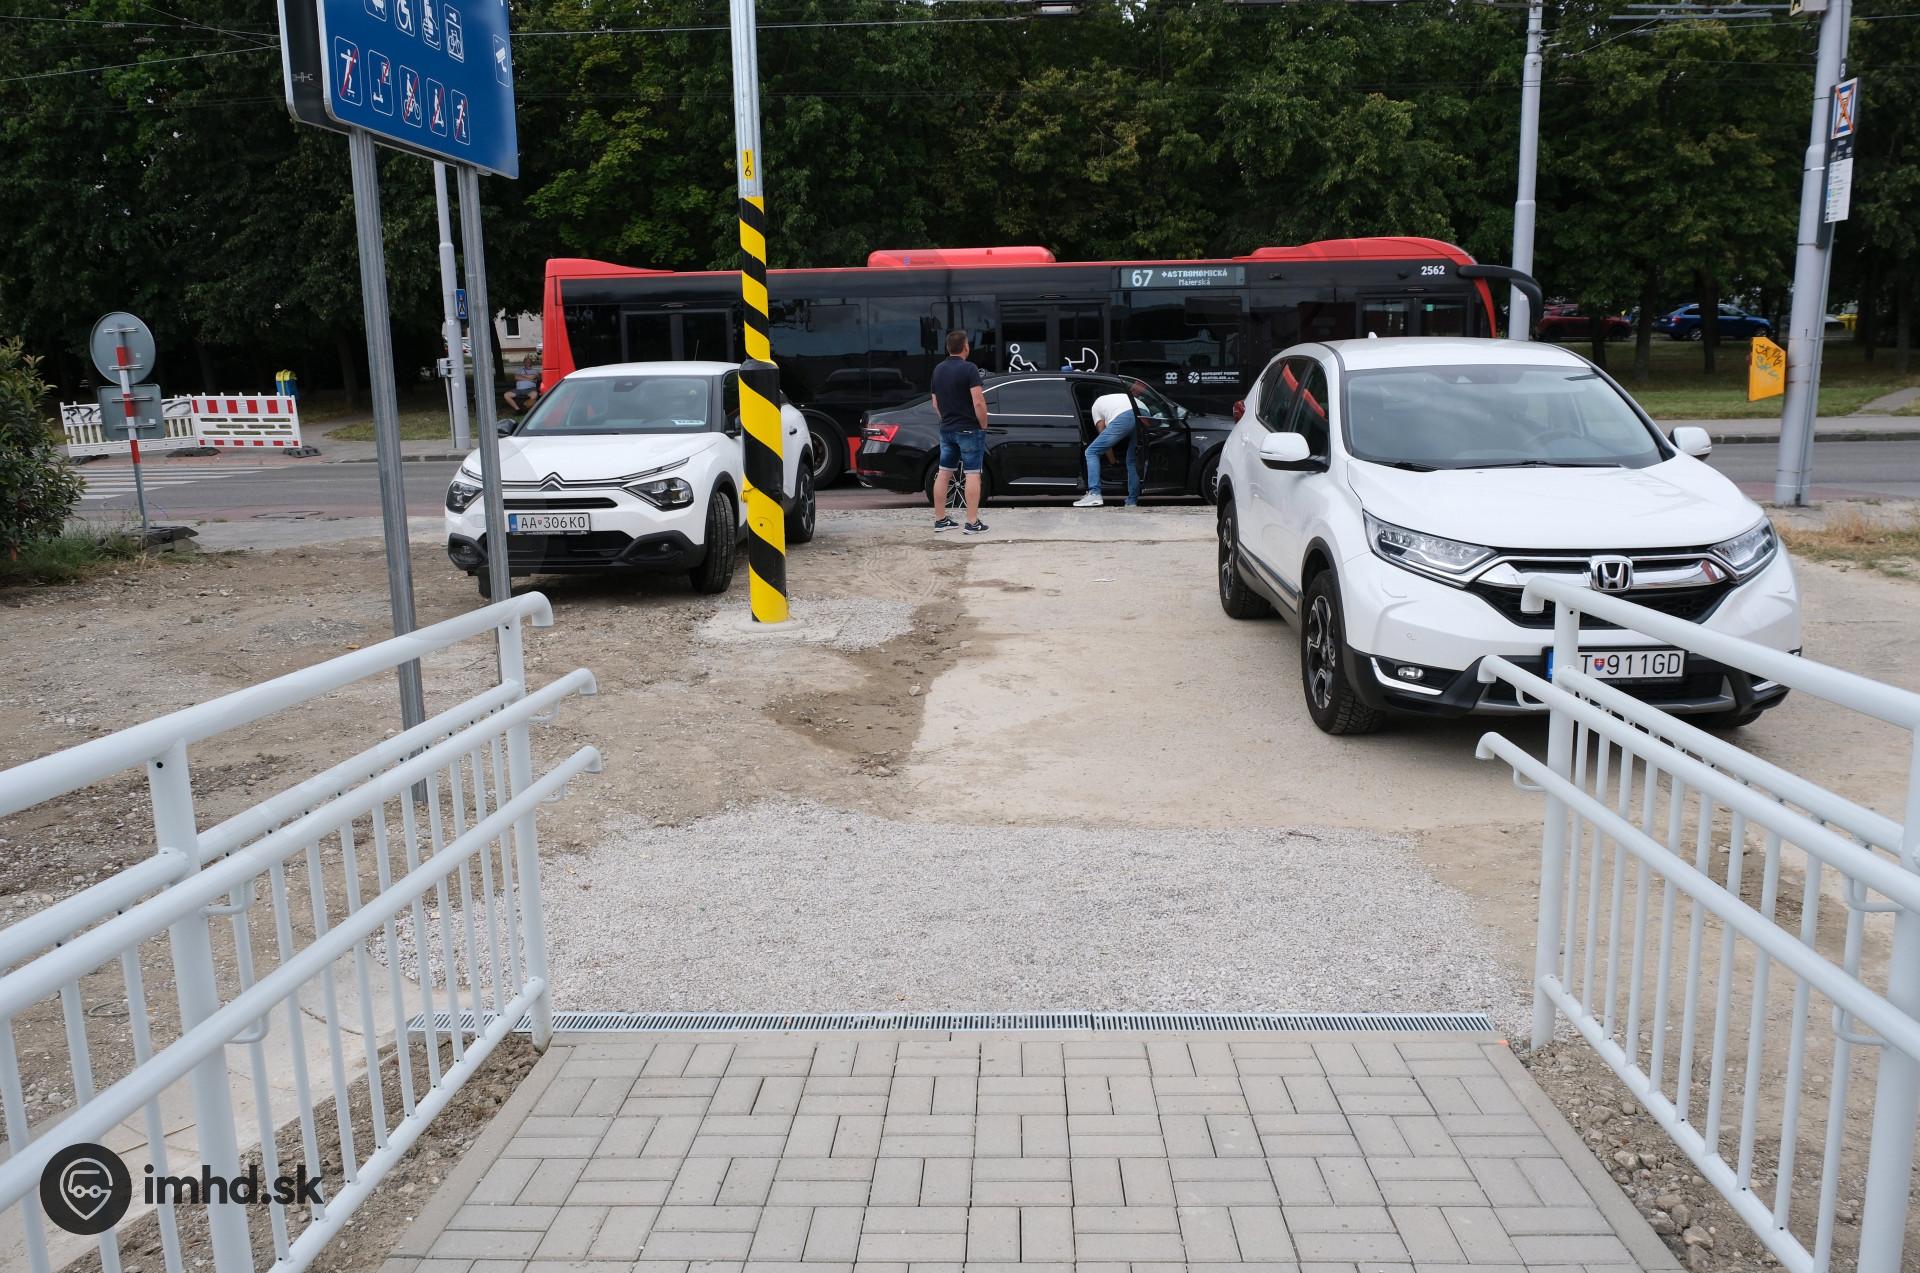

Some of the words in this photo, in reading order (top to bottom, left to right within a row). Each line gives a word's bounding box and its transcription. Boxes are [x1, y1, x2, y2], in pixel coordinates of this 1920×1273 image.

[744, 151, 752, 177] 16
[1131, 269, 1153, 287] 67
[1421, 265, 1445, 276] 2562
[521, 517, 537, 529] AA
[1606, 653, 1680, 676] 911GD
